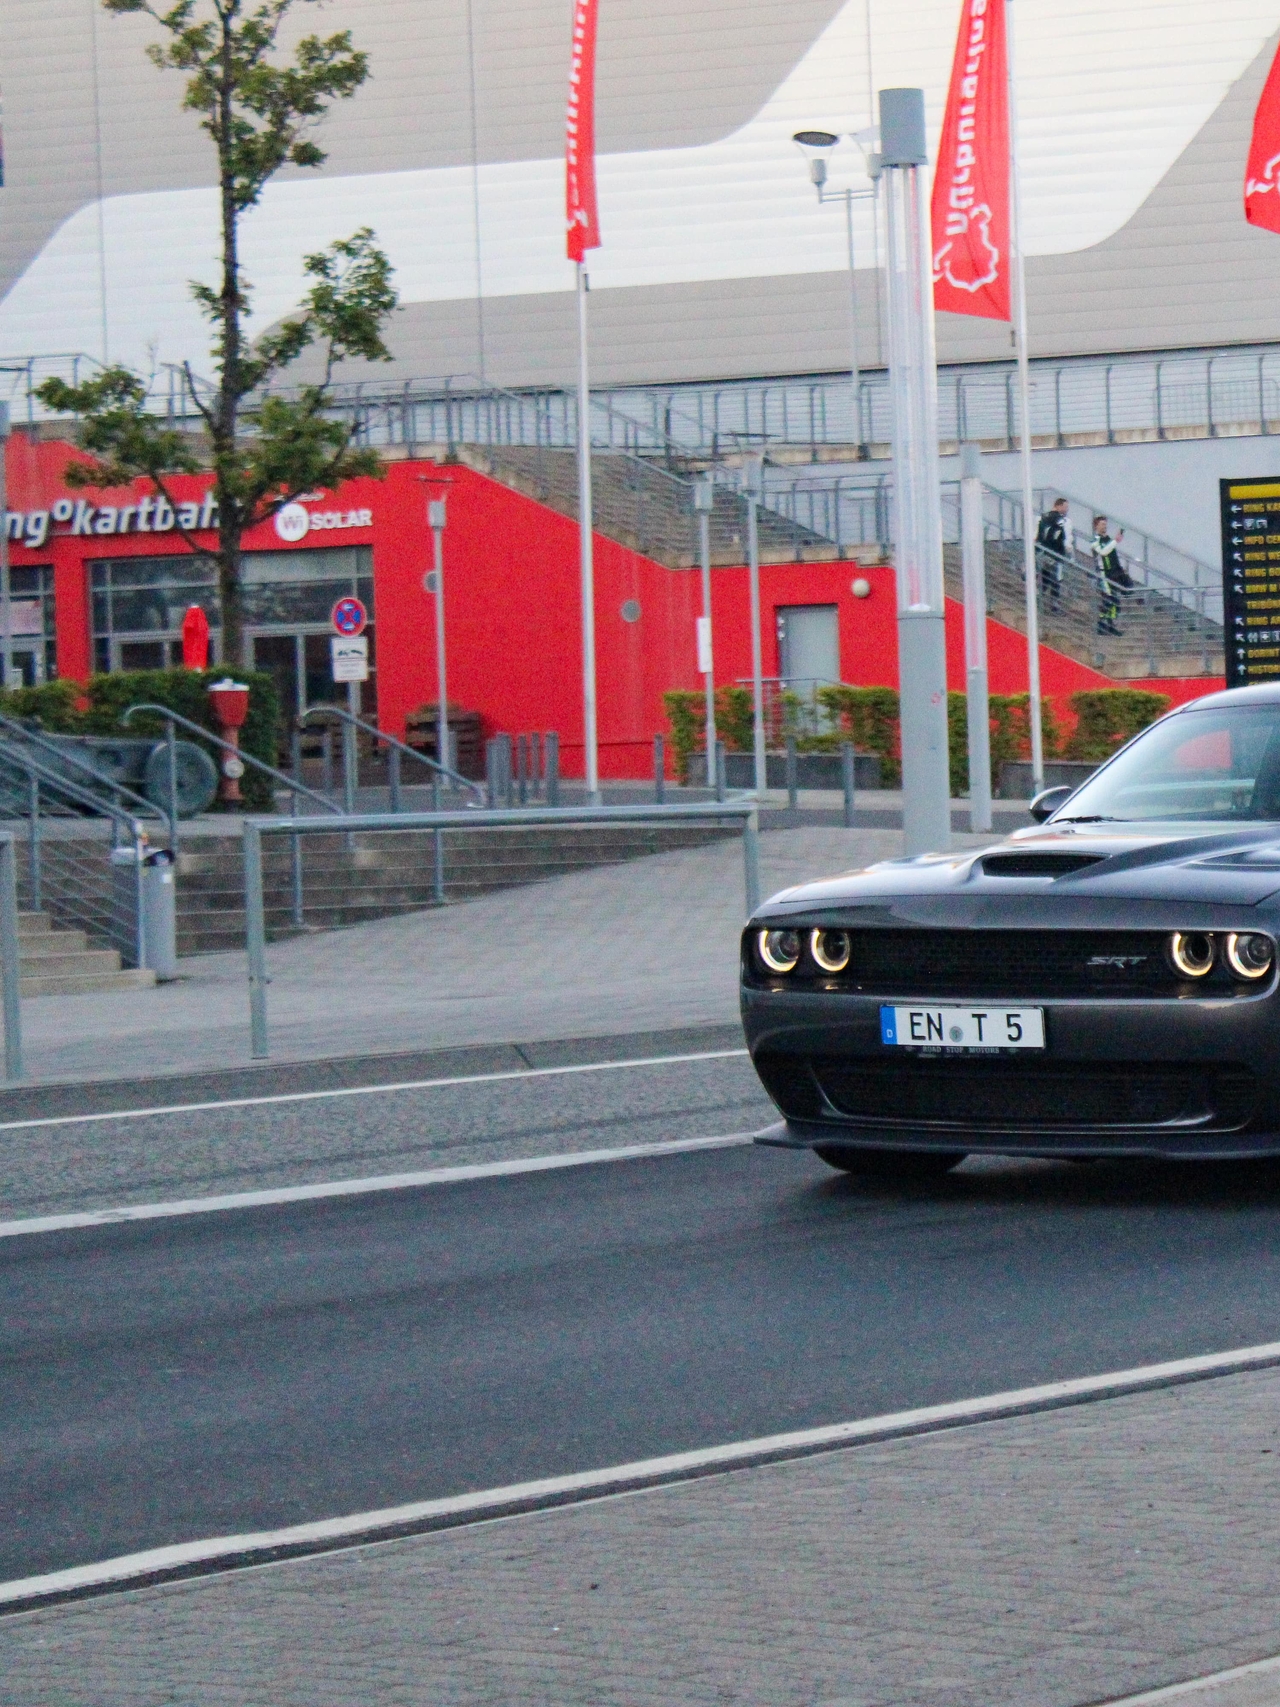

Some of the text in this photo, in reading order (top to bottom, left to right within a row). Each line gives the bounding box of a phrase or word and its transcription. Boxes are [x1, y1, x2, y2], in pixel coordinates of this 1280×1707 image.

[309, 508, 373, 531] SOLAR
[1087, 956, 1147, 968] SRT
[909, 1012, 944, 1041] EN
[971, 1013, 987, 1042] T
[1005, 1013, 1023, 1042] 5
